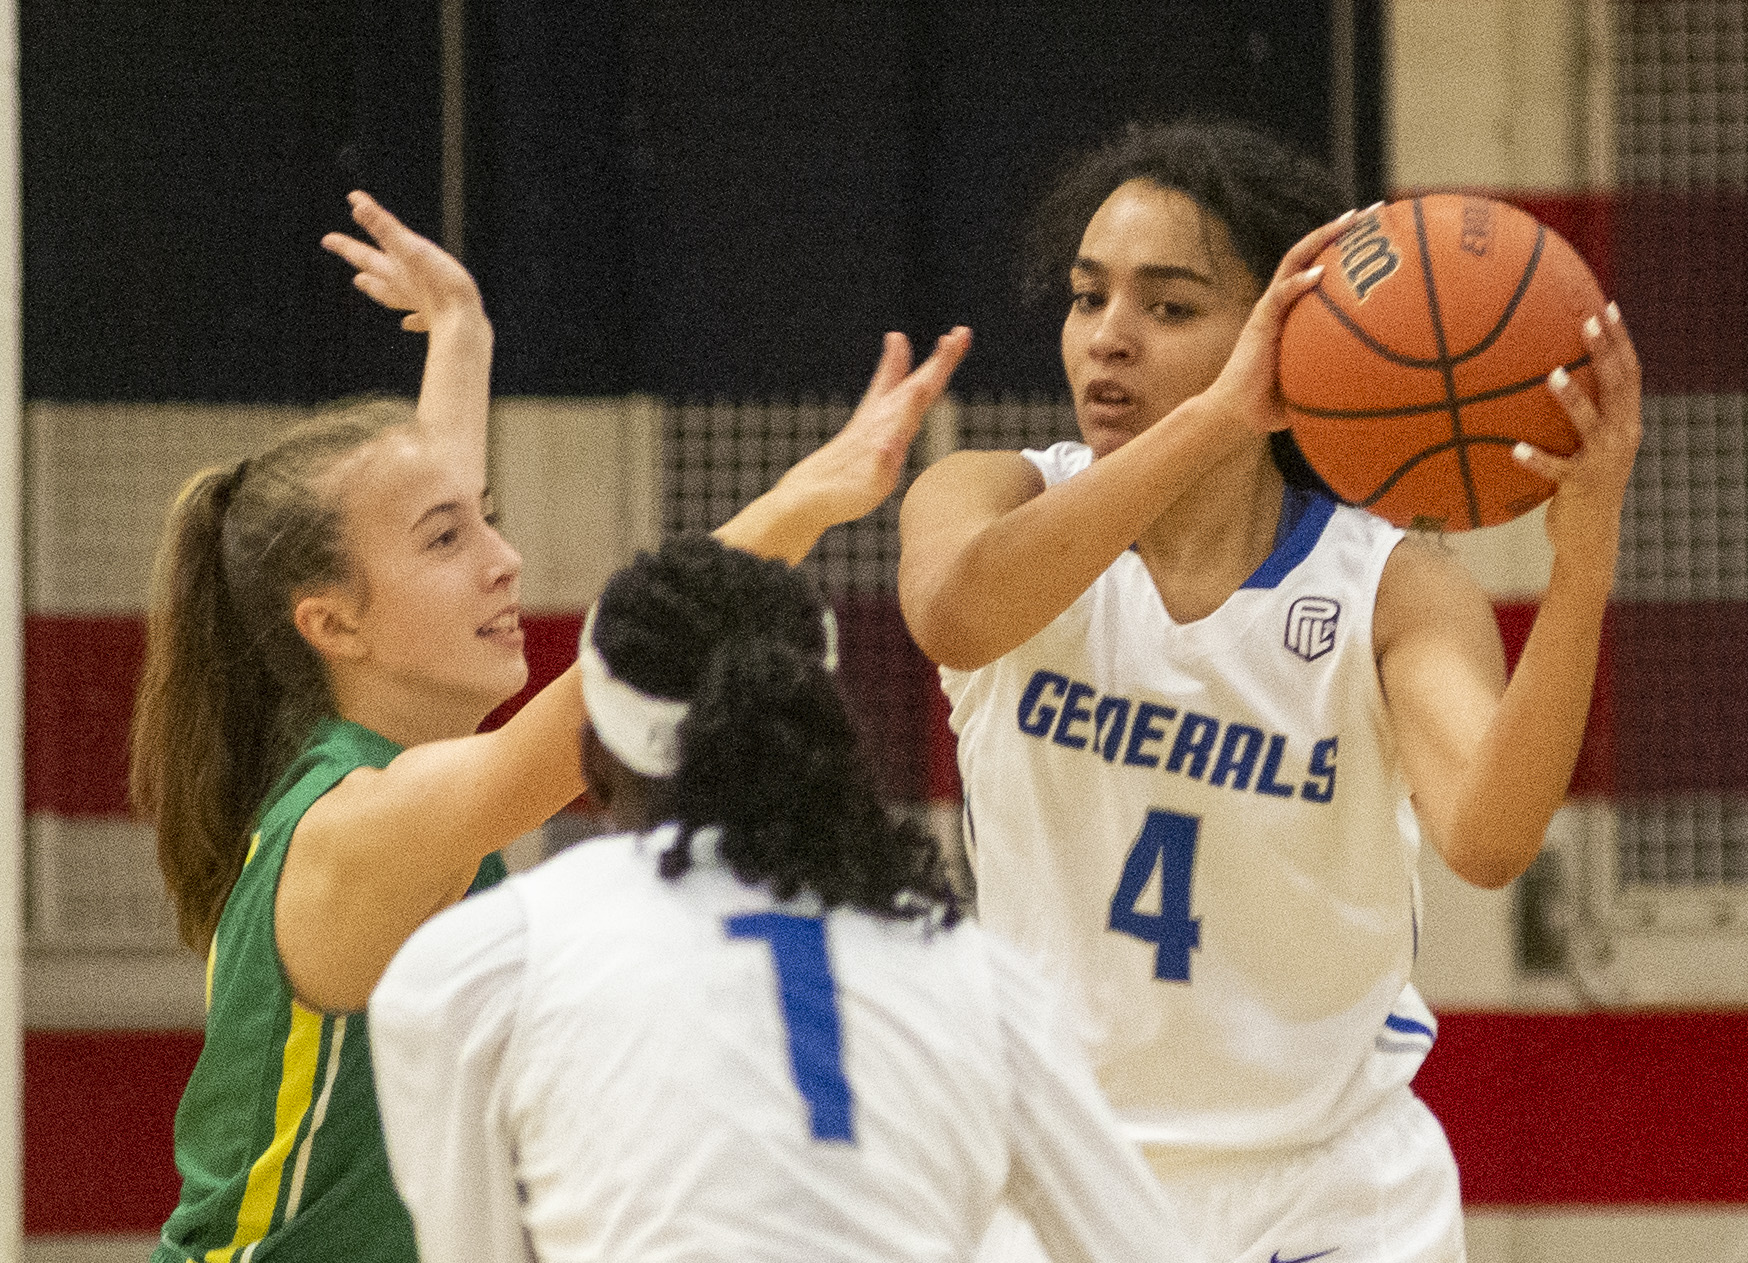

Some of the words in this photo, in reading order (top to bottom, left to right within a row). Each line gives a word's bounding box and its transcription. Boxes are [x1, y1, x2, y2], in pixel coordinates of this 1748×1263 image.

[1017, 668, 1339, 803] GENERALS
[1108, 806, 1202, 983] 4
[723, 912, 857, 1143] 1
